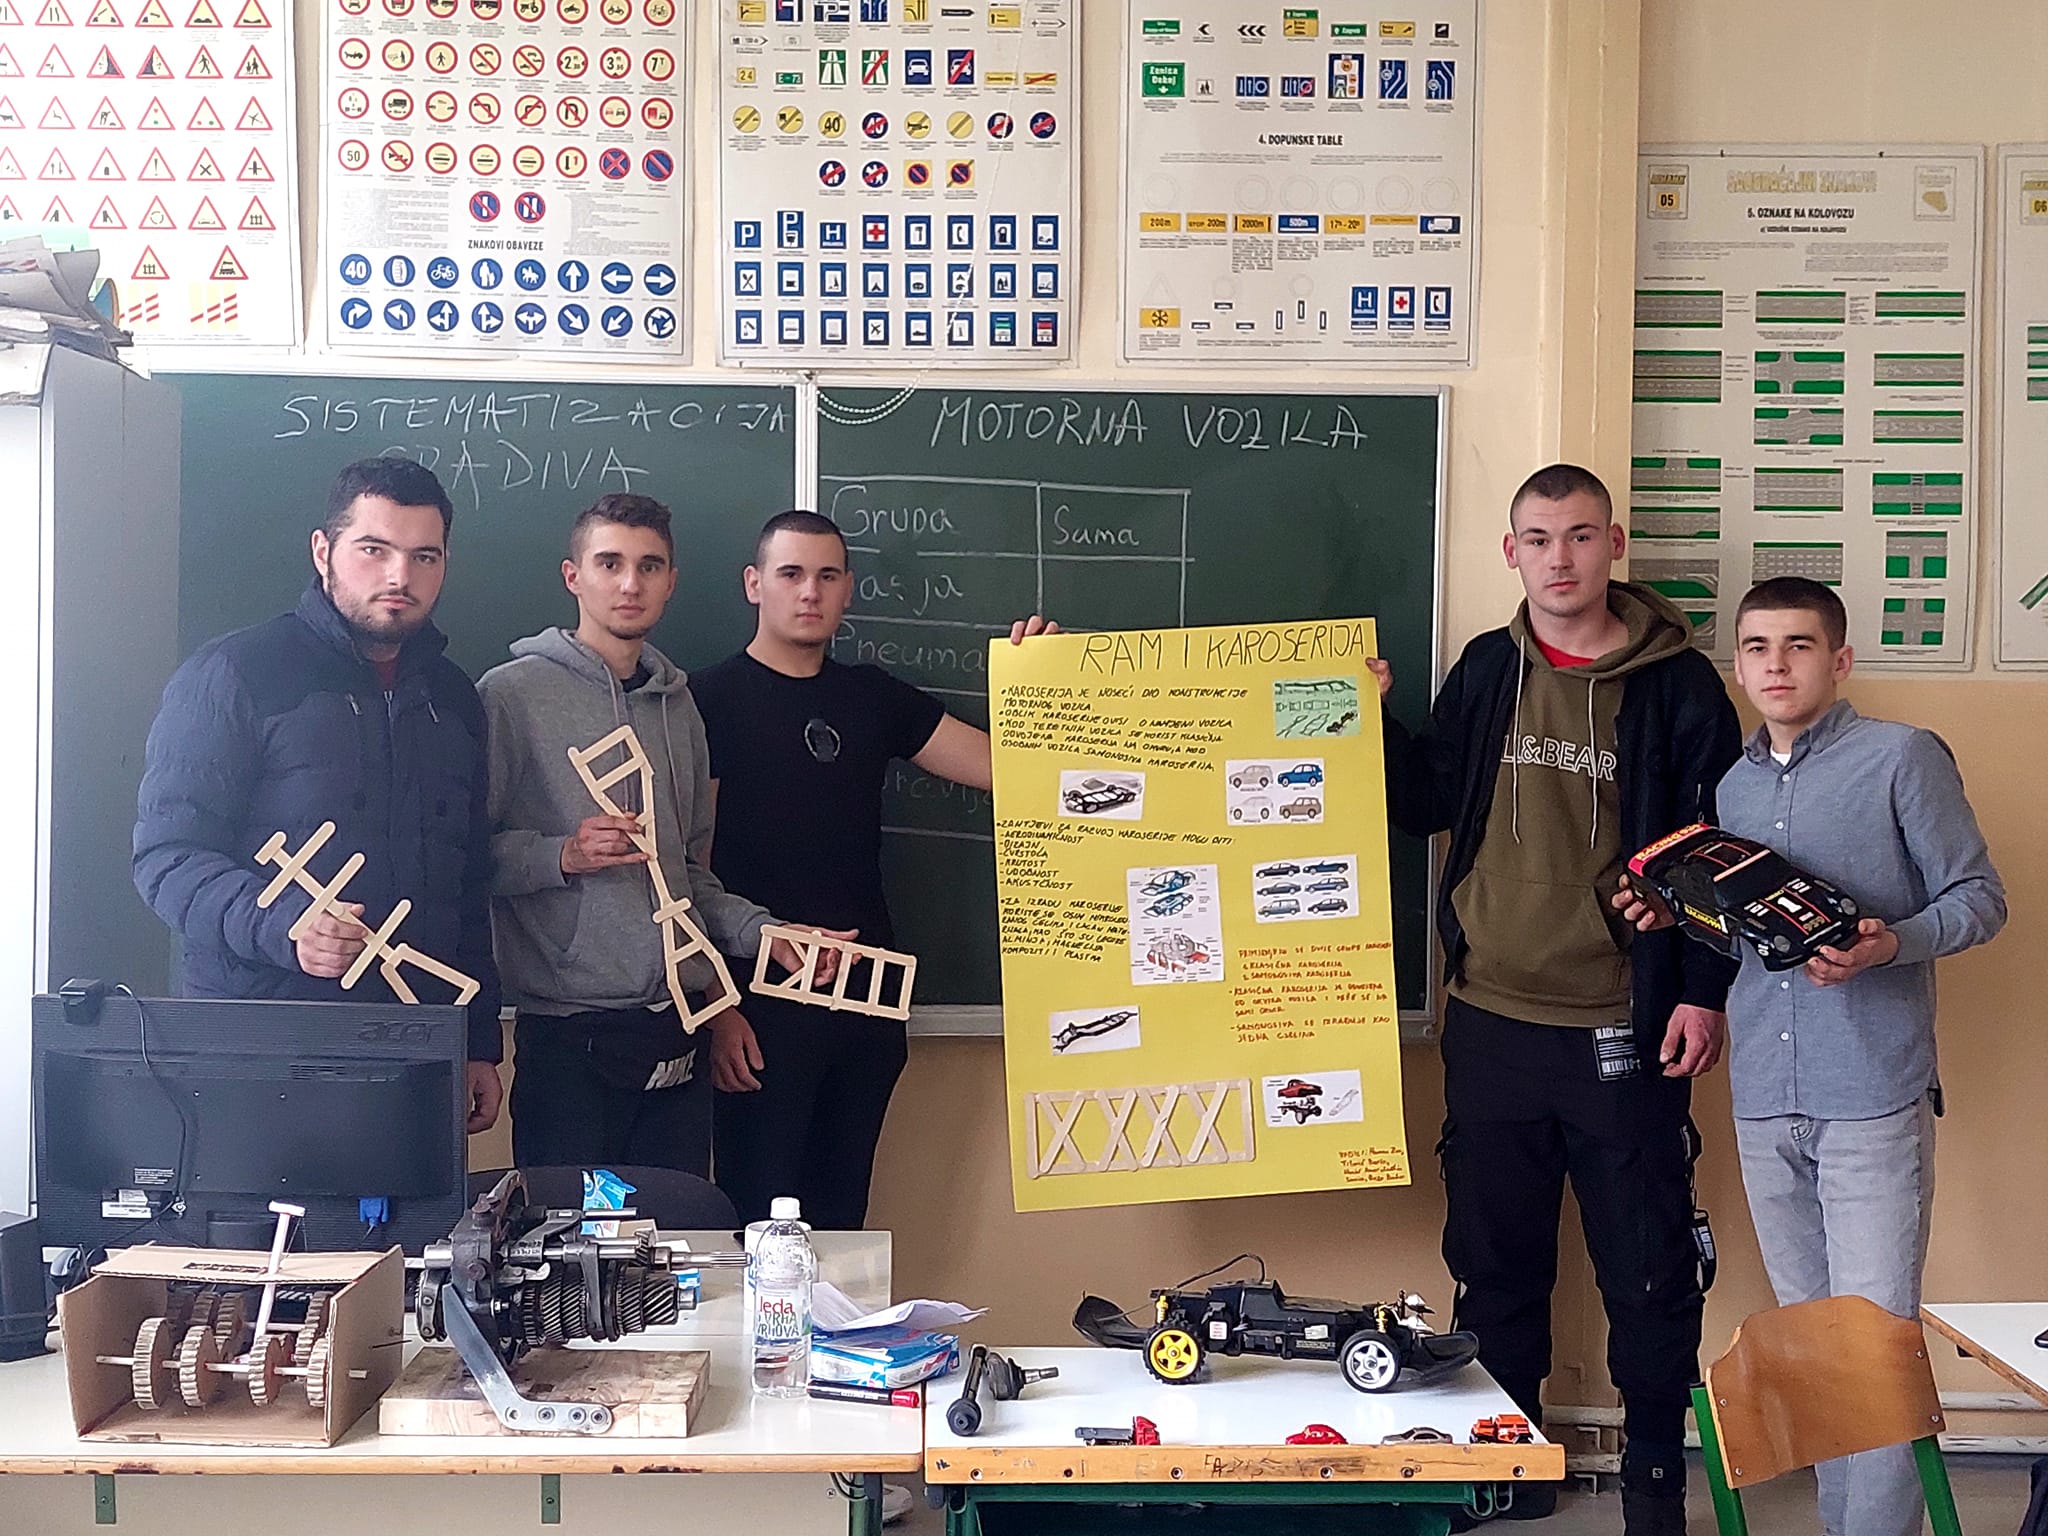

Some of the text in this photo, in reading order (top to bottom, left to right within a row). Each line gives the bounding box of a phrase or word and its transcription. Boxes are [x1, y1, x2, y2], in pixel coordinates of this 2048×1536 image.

[740, 71, 753, 80] 24
[824, 117, 841, 133] 40
[1258, 134, 1344, 146] 4. DOPUNSKE TABLE
[347, 150, 361, 162] 50
[1660, 194, 1674, 207] 05
[1757, 208, 1792, 218] OZNAKE
[1793, 208, 1806, 218] NA
[1808, 208, 1854, 219] KOLOVOZU
[1150, 218, 1171, 227] 200m
[1207, 219, 1226, 227] 200m
[1242, 219, 1264, 228] 2000m
[741, 224, 754, 246] P
[826, 224, 841, 240] H
[468, 239, 544, 251] ZNAKOVI OBAVEZE
[345, 260, 367, 279] 40
[1357, 292, 1372, 308] H
[275, 392, 789, 439] SISTEMATIZACIJA
[930, 396, 1368, 450] MOTORNA VOZILA
[1052, 504, 1140, 547] Suma
[1080, 622, 1365, 676] RAM I KAROSERIJA
[1008, 685, 1073, 698] KAROSERIJA
[1078, 688, 1090, 698] JE
[1142, 688, 1160, 698] DIO
[1168, 687, 1248, 699] KONSTRUKCIJE
[1005, 709, 1036, 718] OBLIK
[1199, 719, 1233, 729] VOZILA
[1005, 719, 1025, 729] KOD
[1128, 730, 1143, 738] SE
[1048, 744, 1080, 754] VOZILA
[1005, 897, 1020, 905] ZA
[1027, 898, 1062, 908] IZRADU
[760, 1295, 793, 1314] leda
